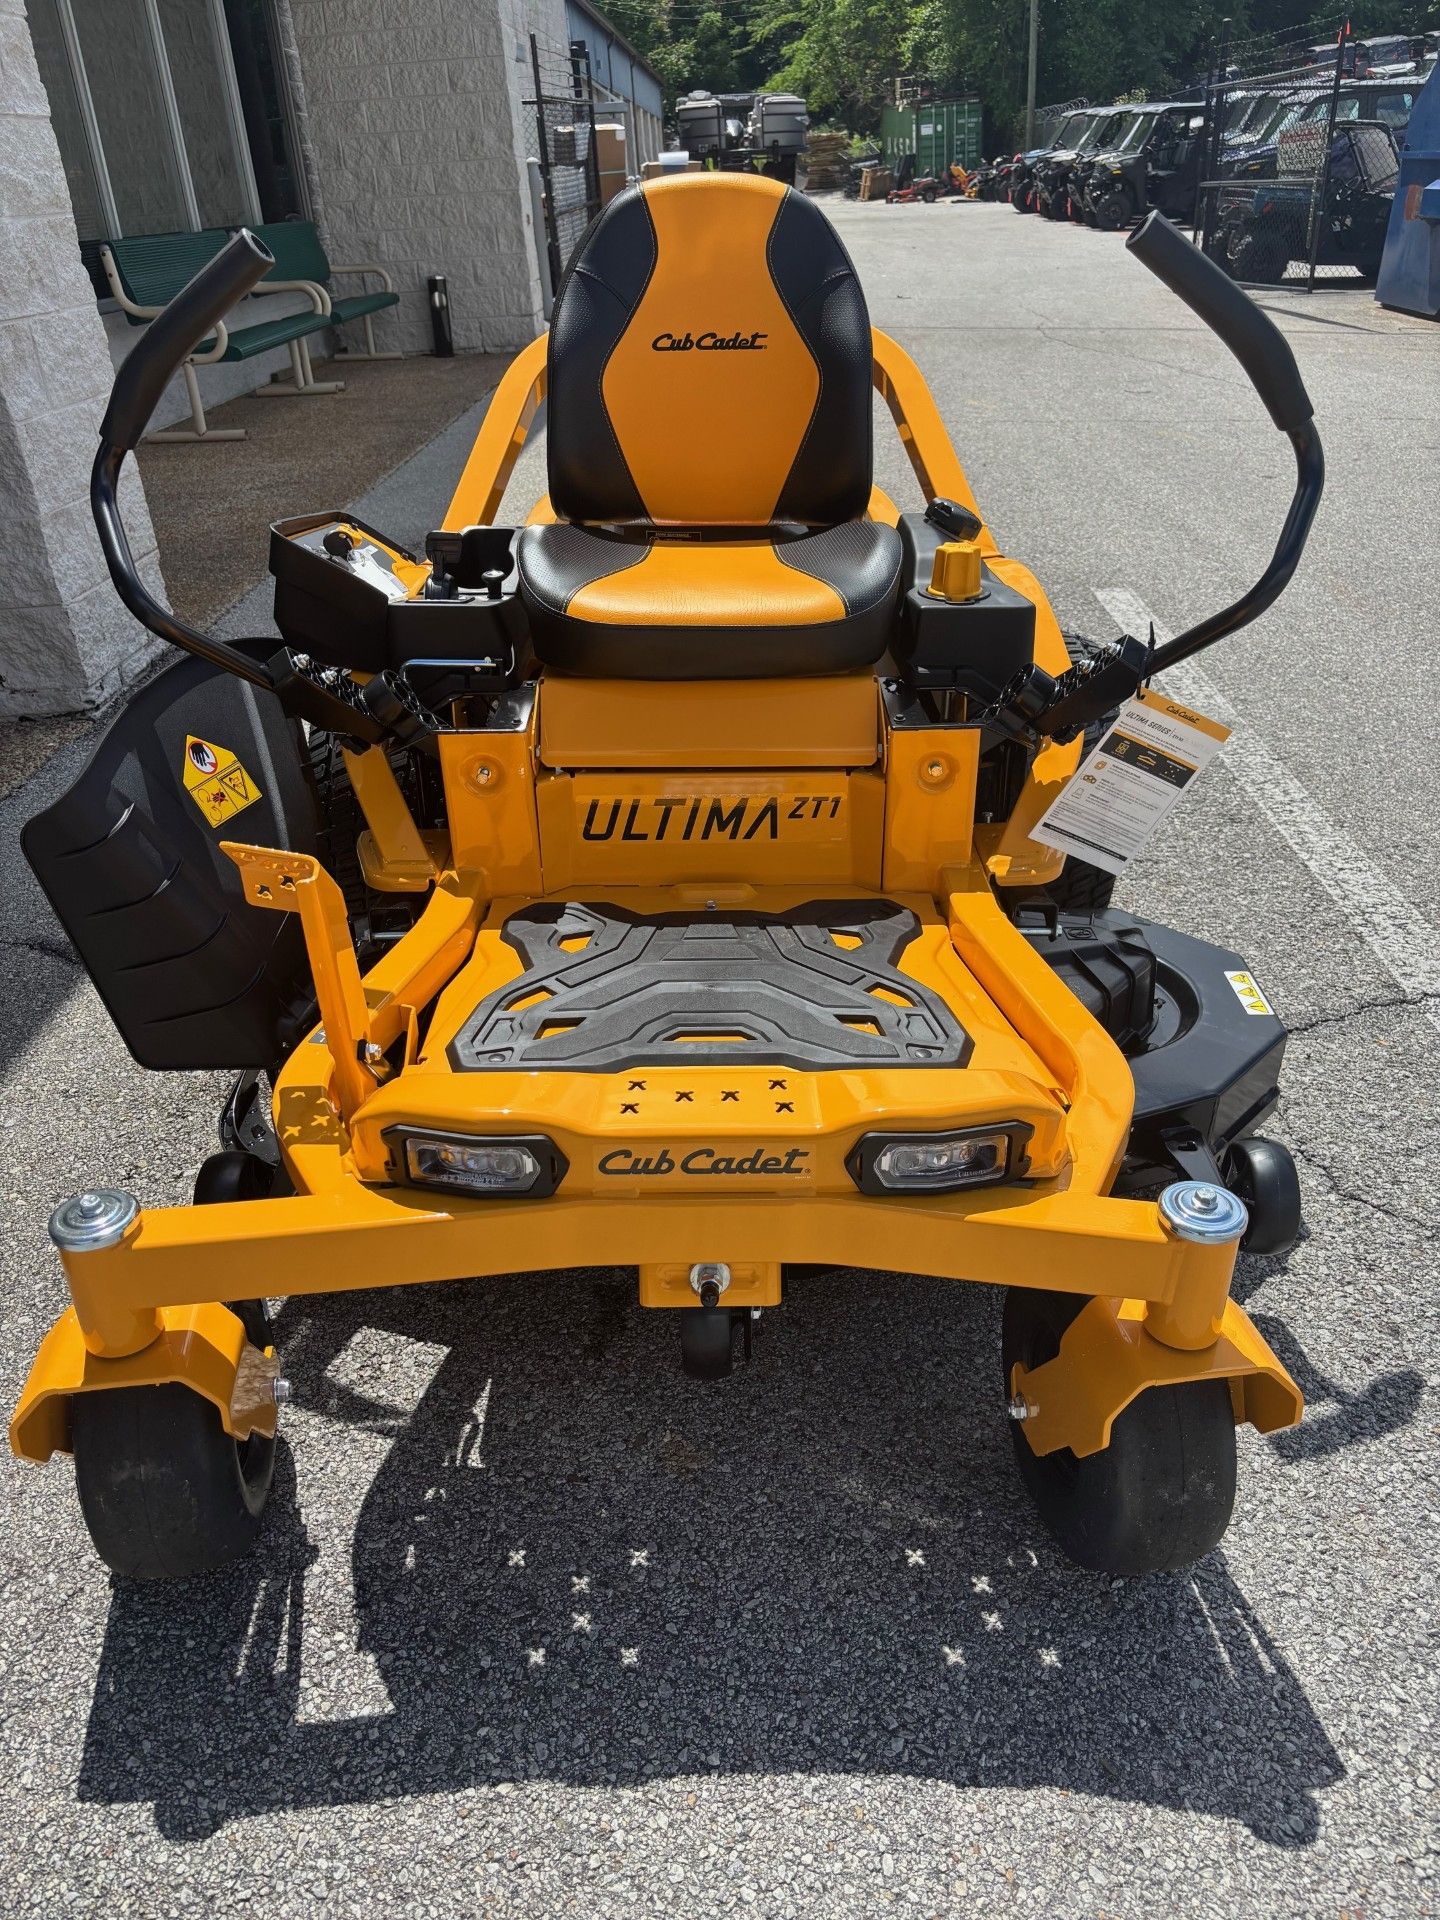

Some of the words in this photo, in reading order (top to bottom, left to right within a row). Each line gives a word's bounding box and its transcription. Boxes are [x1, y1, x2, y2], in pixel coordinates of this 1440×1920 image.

[652, 333, 694, 351] Cub
[695, 332, 768, 350] Cadet
[1125, 711, 1149, 725] ULTIMA
[1147, 721, 1171, 735] SERIES
[583, 797, 778, 841] ULTIMA
[787, 796, 842, 819] ZT1
[598, 1149, 676, 1175] Cub
[680, 1148, 811, 1174] Cadet
